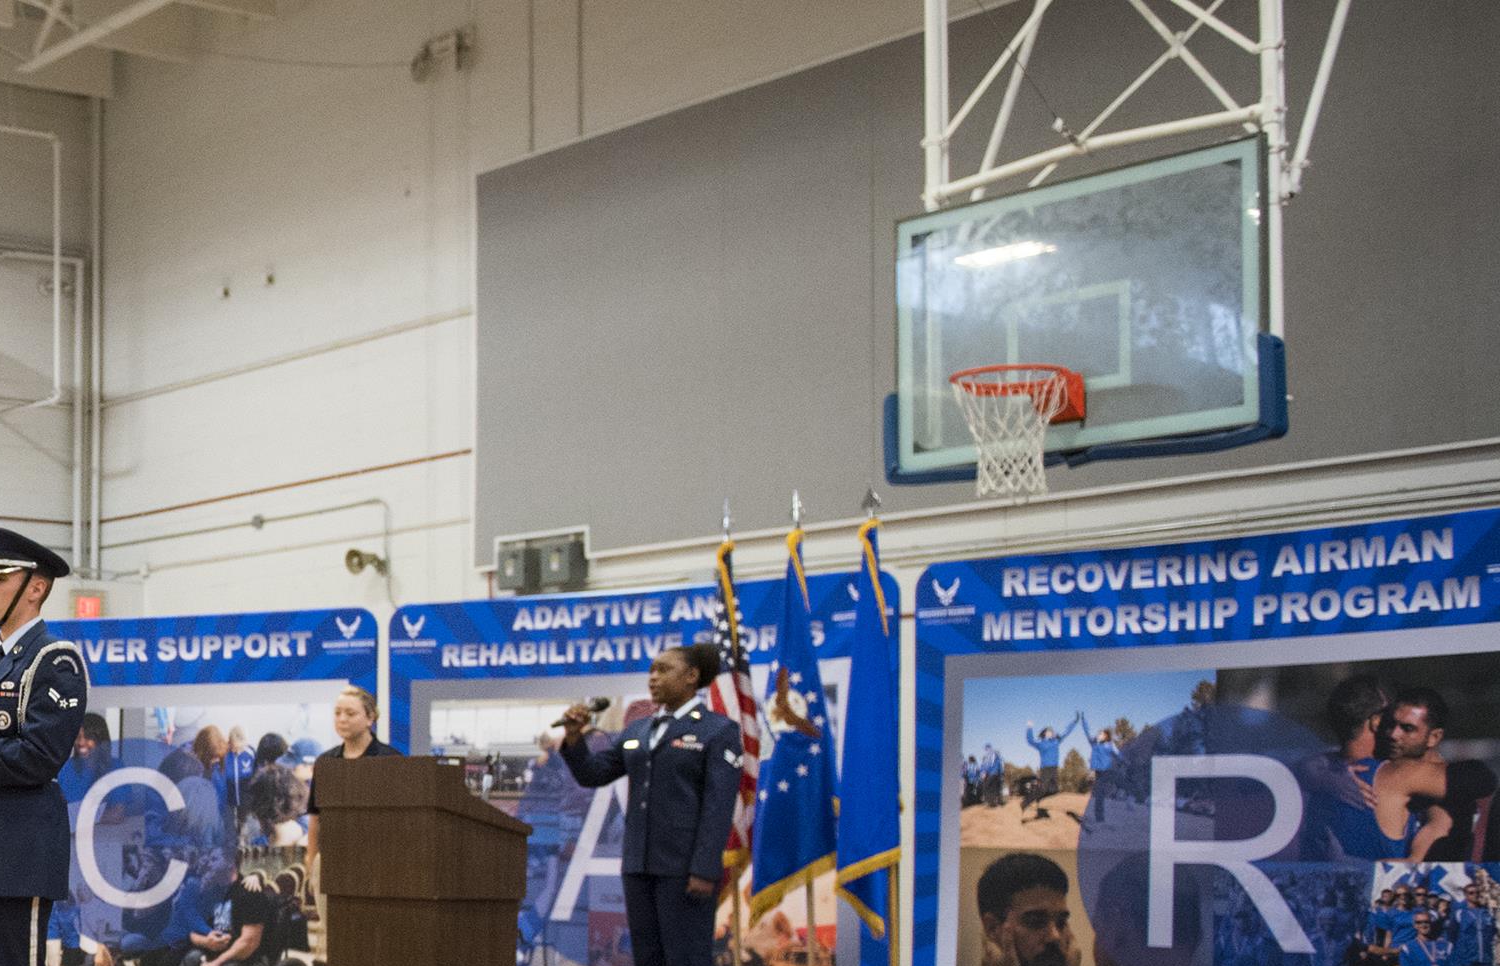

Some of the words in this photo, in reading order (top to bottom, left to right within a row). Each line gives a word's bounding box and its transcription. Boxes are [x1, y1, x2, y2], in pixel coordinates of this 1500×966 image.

[1002, 549, 1260, 598] RECOVERING
[1271, 527, 1454, 578] AIRMAN
[512, 599, 662, 631] ADAPTIVE
[669, 595, 719, 622] AN
[982, 600, 1239, 642] MENTORSHIP
[1253, 575, 1482, 626] PROGRAM
[157, 631, 313, 662] SUPPORT
[76, 766, 189, 909] C
[1147, 754, 1317, 953] R
